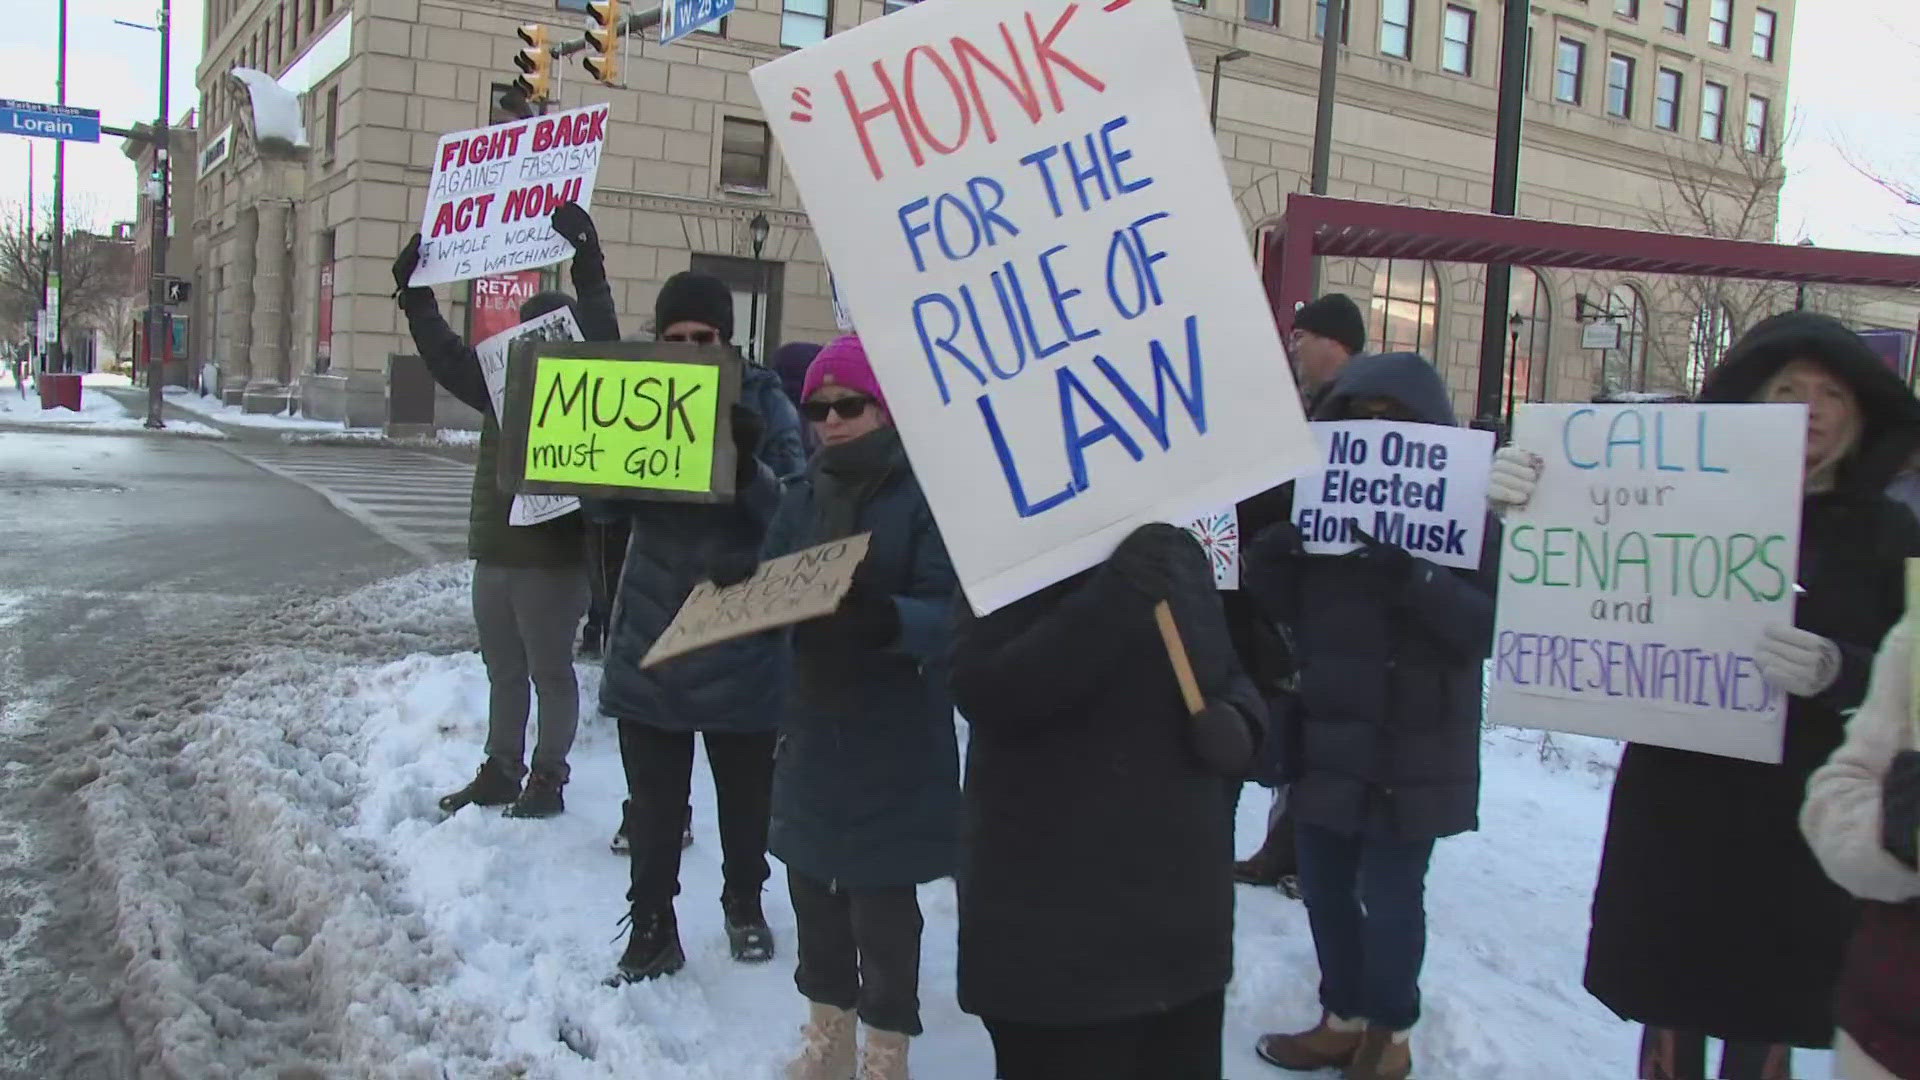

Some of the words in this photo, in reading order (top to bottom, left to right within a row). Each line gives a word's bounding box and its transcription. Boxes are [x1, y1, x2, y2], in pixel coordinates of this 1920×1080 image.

[13, 112, 73, 135] Lorain
[440, 125, 528, 172] FIGHT
[532, 108, 608, 153] BACK
[434, 161, 511, 197] AGAINST
[519, 146, 597, 178] FASCISM
[898, 177, 1019, 272] FOR
[1019, 116, 1153, 218] THE
[432, 193, 495, 238] ACT
[502, 177, 582, 224] NOW!
[438, 235, 490, 260] WHOLE
[505, 225, 556, 245] WORLD
[454, 260, 471, 277] IS
[484, 243, 567, 272] WATCHING!
[476, 279, 533, 297] RETAIL
[911, 245, 1101, 406] RULE
[1105, 211, 1169, 319] OF
[537, 371, 701, 443] MUSK
[976, 315, 1207, 518] LAW
[533, 432, 604, 471] must
[624, 446, 681, 479] GO!
[1329, 431, 1367, 465] No
[1380, 431, 1448, 471] One
[1563, 409, 1729, 473] CALL
[1322, 469, 1446, 512] Elected
[1590, 483, 1675, 525] your
[1299, 509, 1358, 544] Elon
[1373, 511, 1468, 556] Musk
[1508, 525, 1785, 602] SENATORS
[1590, 596, 1654, 624] and
